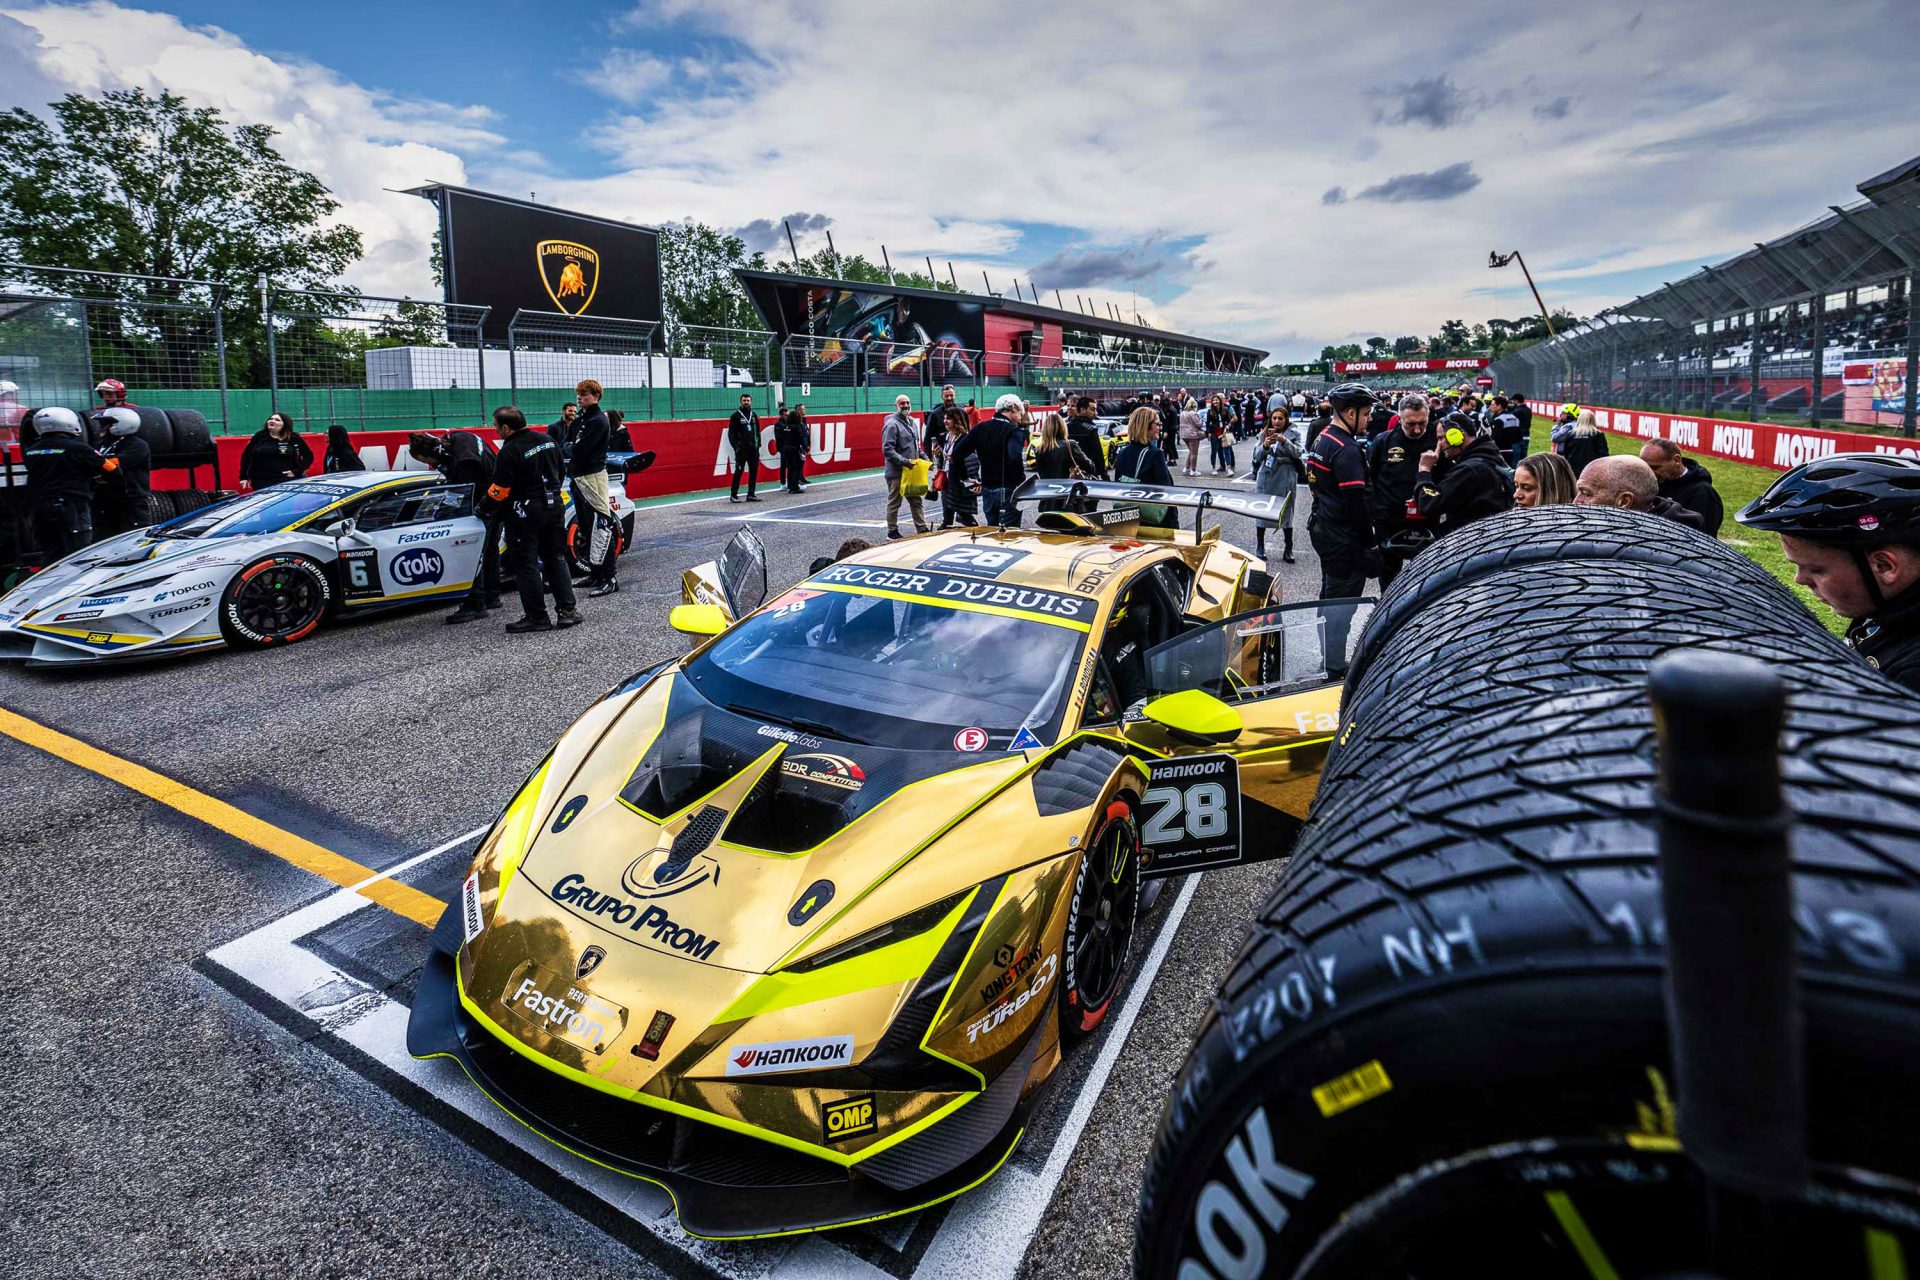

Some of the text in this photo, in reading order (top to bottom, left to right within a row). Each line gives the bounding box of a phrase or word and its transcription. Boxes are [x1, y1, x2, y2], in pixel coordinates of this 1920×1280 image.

[541, 244, 595, 263] LAMBORGHINI
[807, 289, 815, 320] COSTA
[1345, 362, 1378, 371] MOTUL
[1394, 361, 1428, 370] MOTUL
[1445, 359, 1480, 368] MOTUL
[803, 384, 809, 395] 2
[1669, 419, 1700, 448] MOTUL
[1711, 424, 1755, 459] MOTUL
[713, 421, 852, 477] MOUL
[1111, 489, 1277, 513] randtad
[1102, 508, 1140, 525] ROGER DUBUIS
[398, 529, 451, 545] Fastron
[394, 552, 441, 583] Croky
[936, 547, 1014, 568] 28
[349, 560, 369, 587] 6
[1075, 568, 1113, 595] BDR
[171, 580, 216, 598] TOPCON
[822, 566, 1084, 616] ROGER DUBUIS
[772, 600, 806, 619] 28
[965, 731, 979, 746] E
[781, 760, 865, 788] BDR COMPETITION
[1140, 782, 1228, 846] 28
[1157, 844, 1237, 860] SQUADRA CORSE
[630, 904, 721, 961] PROM
[980, 973, 1012, 1003] KING
[512, 978, 606, 1044] Fastron
[967, 967, 1049, 1044] TURBO
[650, 1013, 667, 1040] OMP
[827, 1104, 873, 1131] OMP
